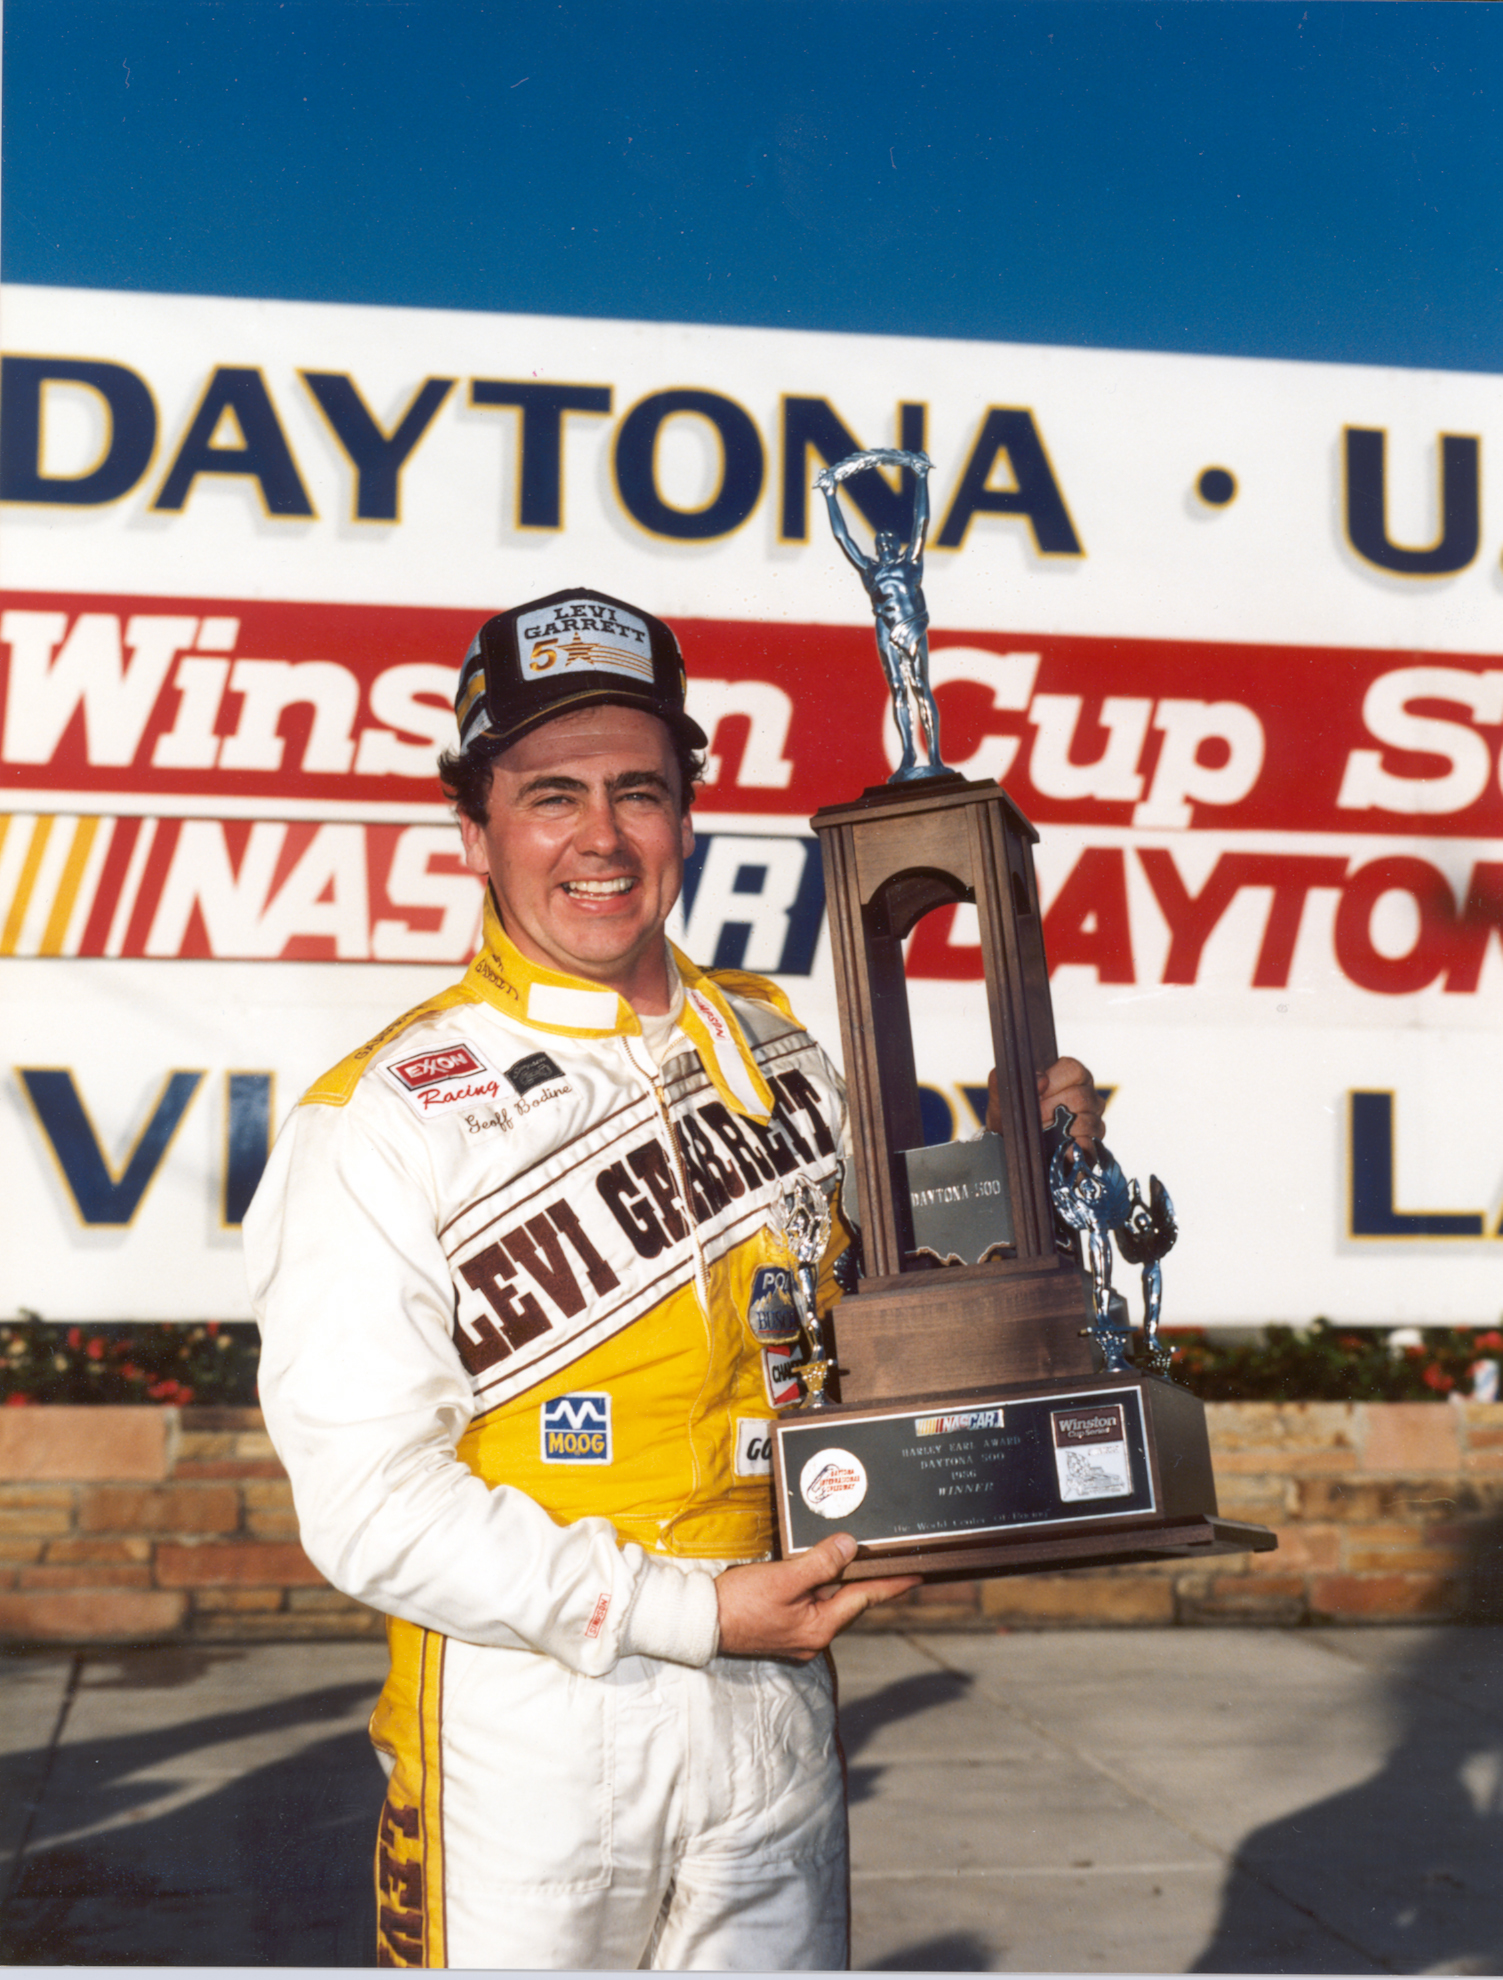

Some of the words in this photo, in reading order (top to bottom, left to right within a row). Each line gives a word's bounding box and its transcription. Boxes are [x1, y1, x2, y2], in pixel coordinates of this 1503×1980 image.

[0, 353, 1088, 560] DAYTONA
[1341, 423, 1503, 582] U
[553, 604, 617, 622] LEVI
[524, 618, 645, 643] GARRETT
[529, 638, 559, 672] 5
[0, 611, 796, 790] Winsn
[883, 648, 1266, 829] Cup
[1336, 666, 1503, 816] S
[143, 820, 808, 975] NASR
[404, 1053, 469, 1079] EXXON
[417, 1080, 500, 1110] Racing
[465, 1108, 514, 1134] Geoff
[514, 1085, 572, 1116] Bodine
[1346, 1087, 1503, 1242] L
[911, 1184, 969, 1207] DAYTONA
[974, 1180, 1001, 1198] 500
[452, 1198, 621, 1377] LEVI
[595, 1068, 836, 1260] GARRETT
[1059, 1415, 1117, 1432] Winston
[1067, 1429, 1085, 1440] Cup
[1085, 1426, 1110, 1437] Series
[549, 1432, 605, 1453] MOOG
[902, 1444, 942, 1458] HARLEY
[949, 1441, 975, 1452] EARL
[983, 1436, 1021, 1448] AWARD
[920, 1455, 974, 1470] DAYTONA
[981, 1452, 1005, 1462] 500
[951, 1470, 977, 1481] 1986
[938, 1482, 994, 1496] WINNER
